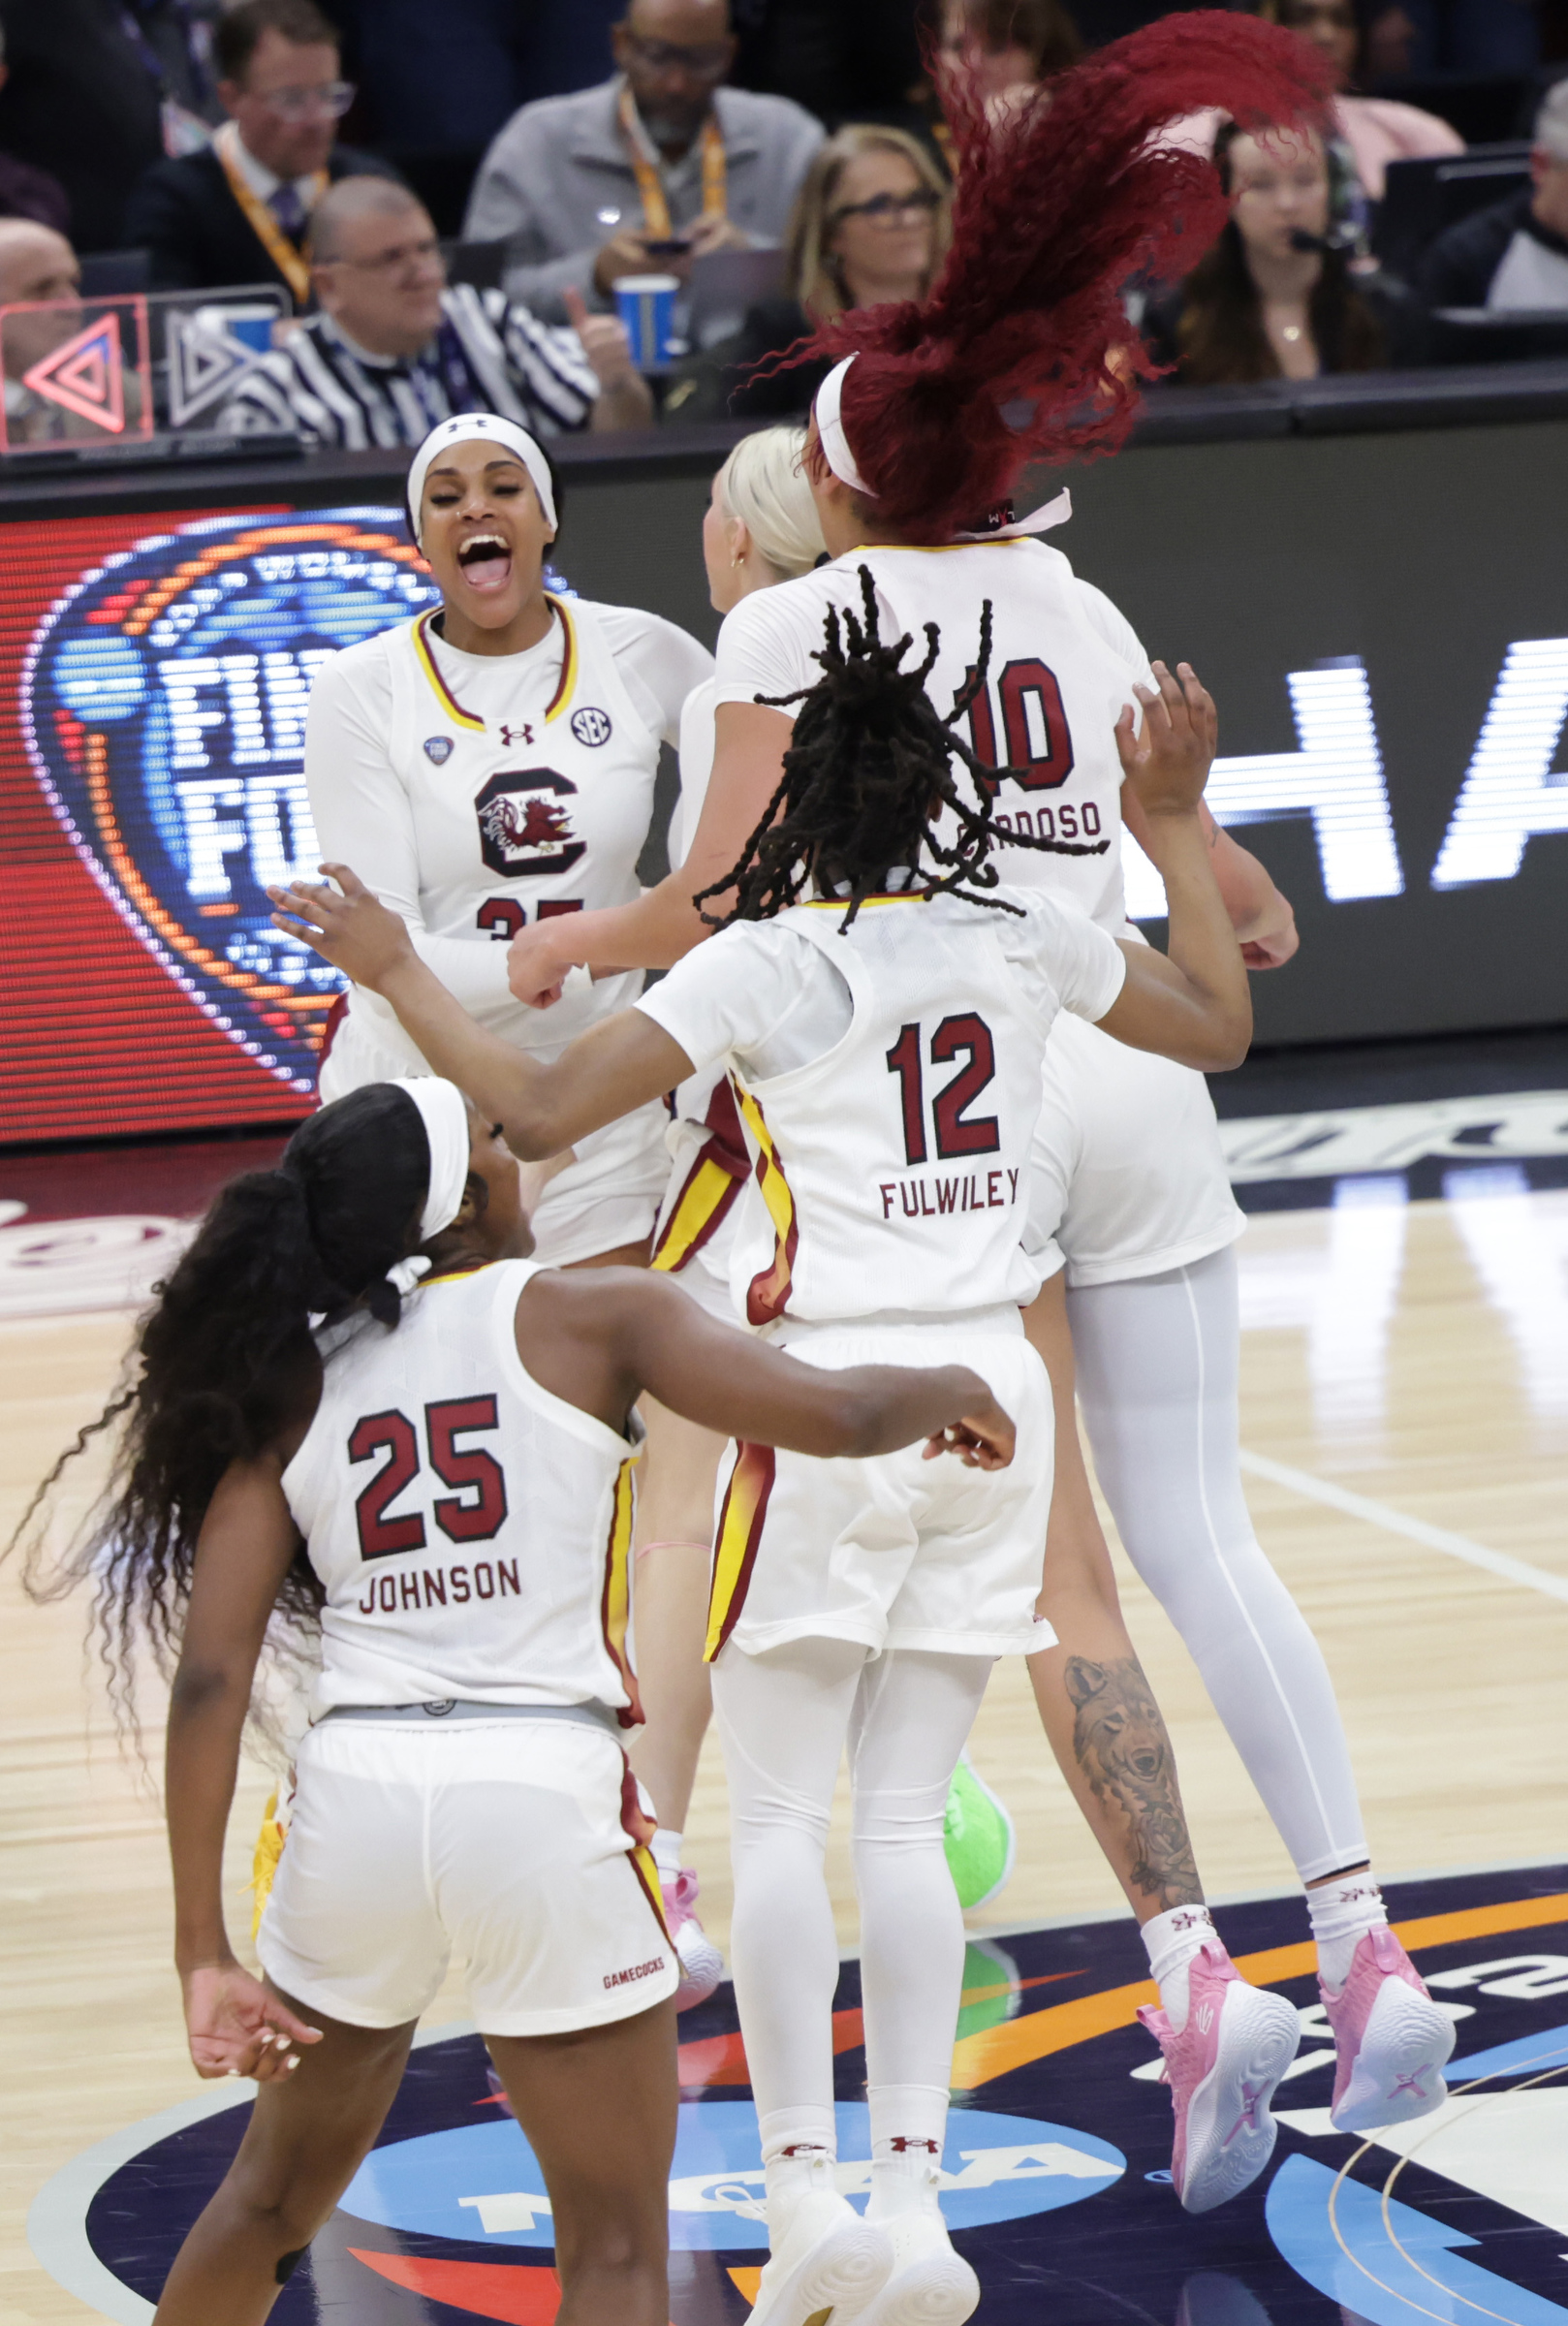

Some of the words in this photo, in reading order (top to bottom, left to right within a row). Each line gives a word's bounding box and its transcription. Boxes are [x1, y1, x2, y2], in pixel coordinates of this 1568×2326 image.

[571, 708, 612, 746] SEC
[953, 657, 1076, 797] 10
[886, 1011, 1000, 1167] 12
[879, 1168, 1019, 1219] FULWILEY
[347, 1393, 509, 1562] 25
[360, 1558, 521, 1615] JOHNSON
[603, 1956, 665, 1990] GAMECOCKS
